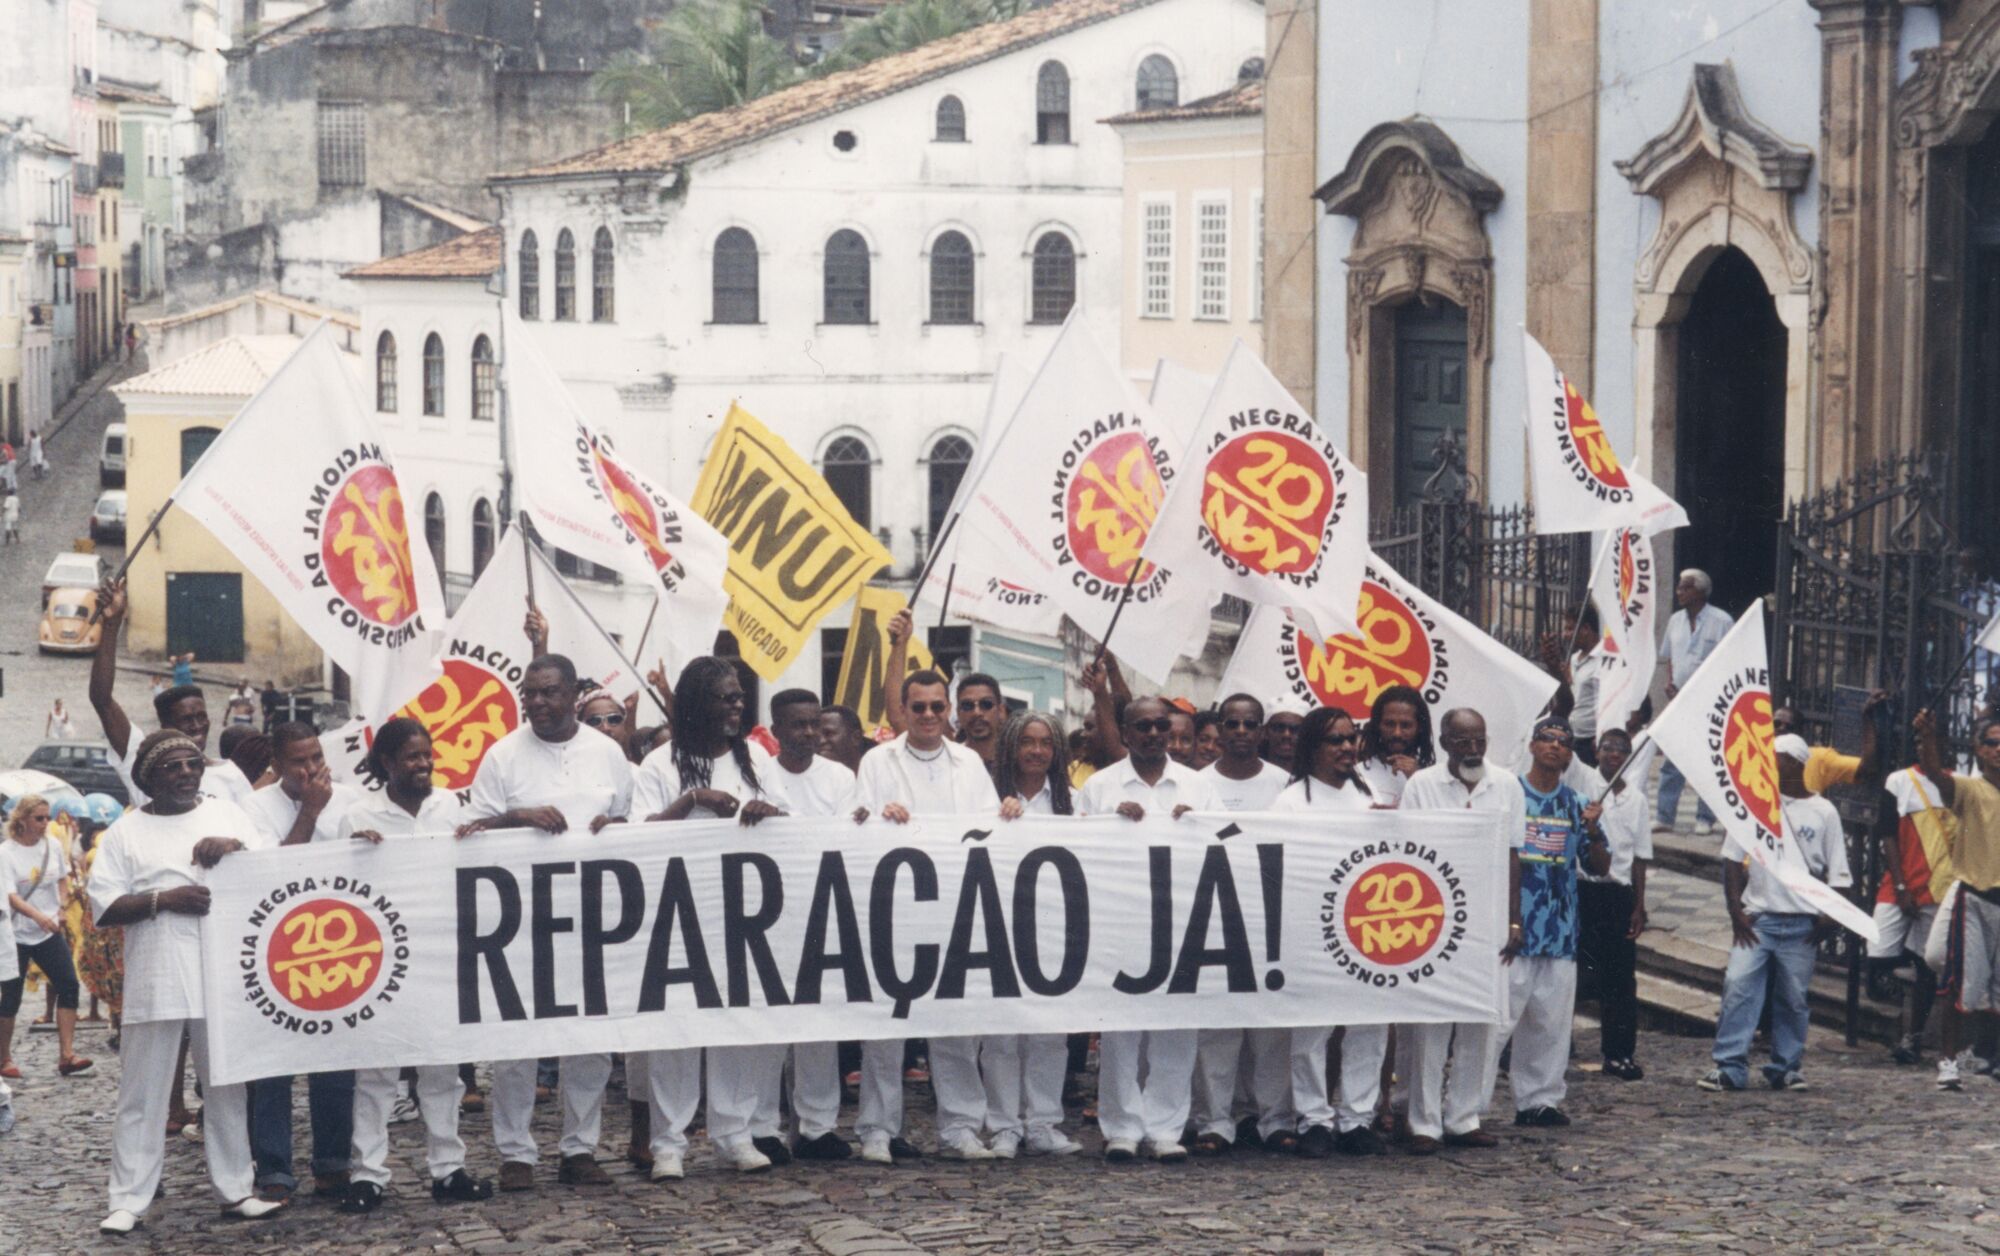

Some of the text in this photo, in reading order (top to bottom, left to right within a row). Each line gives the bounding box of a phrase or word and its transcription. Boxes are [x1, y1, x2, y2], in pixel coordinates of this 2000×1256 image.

[1229, 408, 1313, 440] NEGRA
[1236, 439, 1325, 520] 20
[1323, 441, 1346, 485] DIA
[711, 449, 855, 603] MNU
[1204, 488, 1301, 570] NOV
[1636, 559, 1650, 594] DIA
[1404, 597, 1436, 632] DIA
[1706, 674, 1748, 821] CONSCIÊNCIA
[1360, 872, 1423, 911] 20
[284, 908, 357, 954] 20
[455, 822, 1286, 1024] REPARAÇÃO JÁ!
[1320, 841, 1467, 989] DIA NACIONAL DA CONSCIÊNCIA NEGRA
[1361, 918, 1435, 954] NOV
[240, 876, 410, 1035] DIA NACIONAL DA CONSCIÊNCIA NEGRA
[288, 956, 372, 1000] NOV
